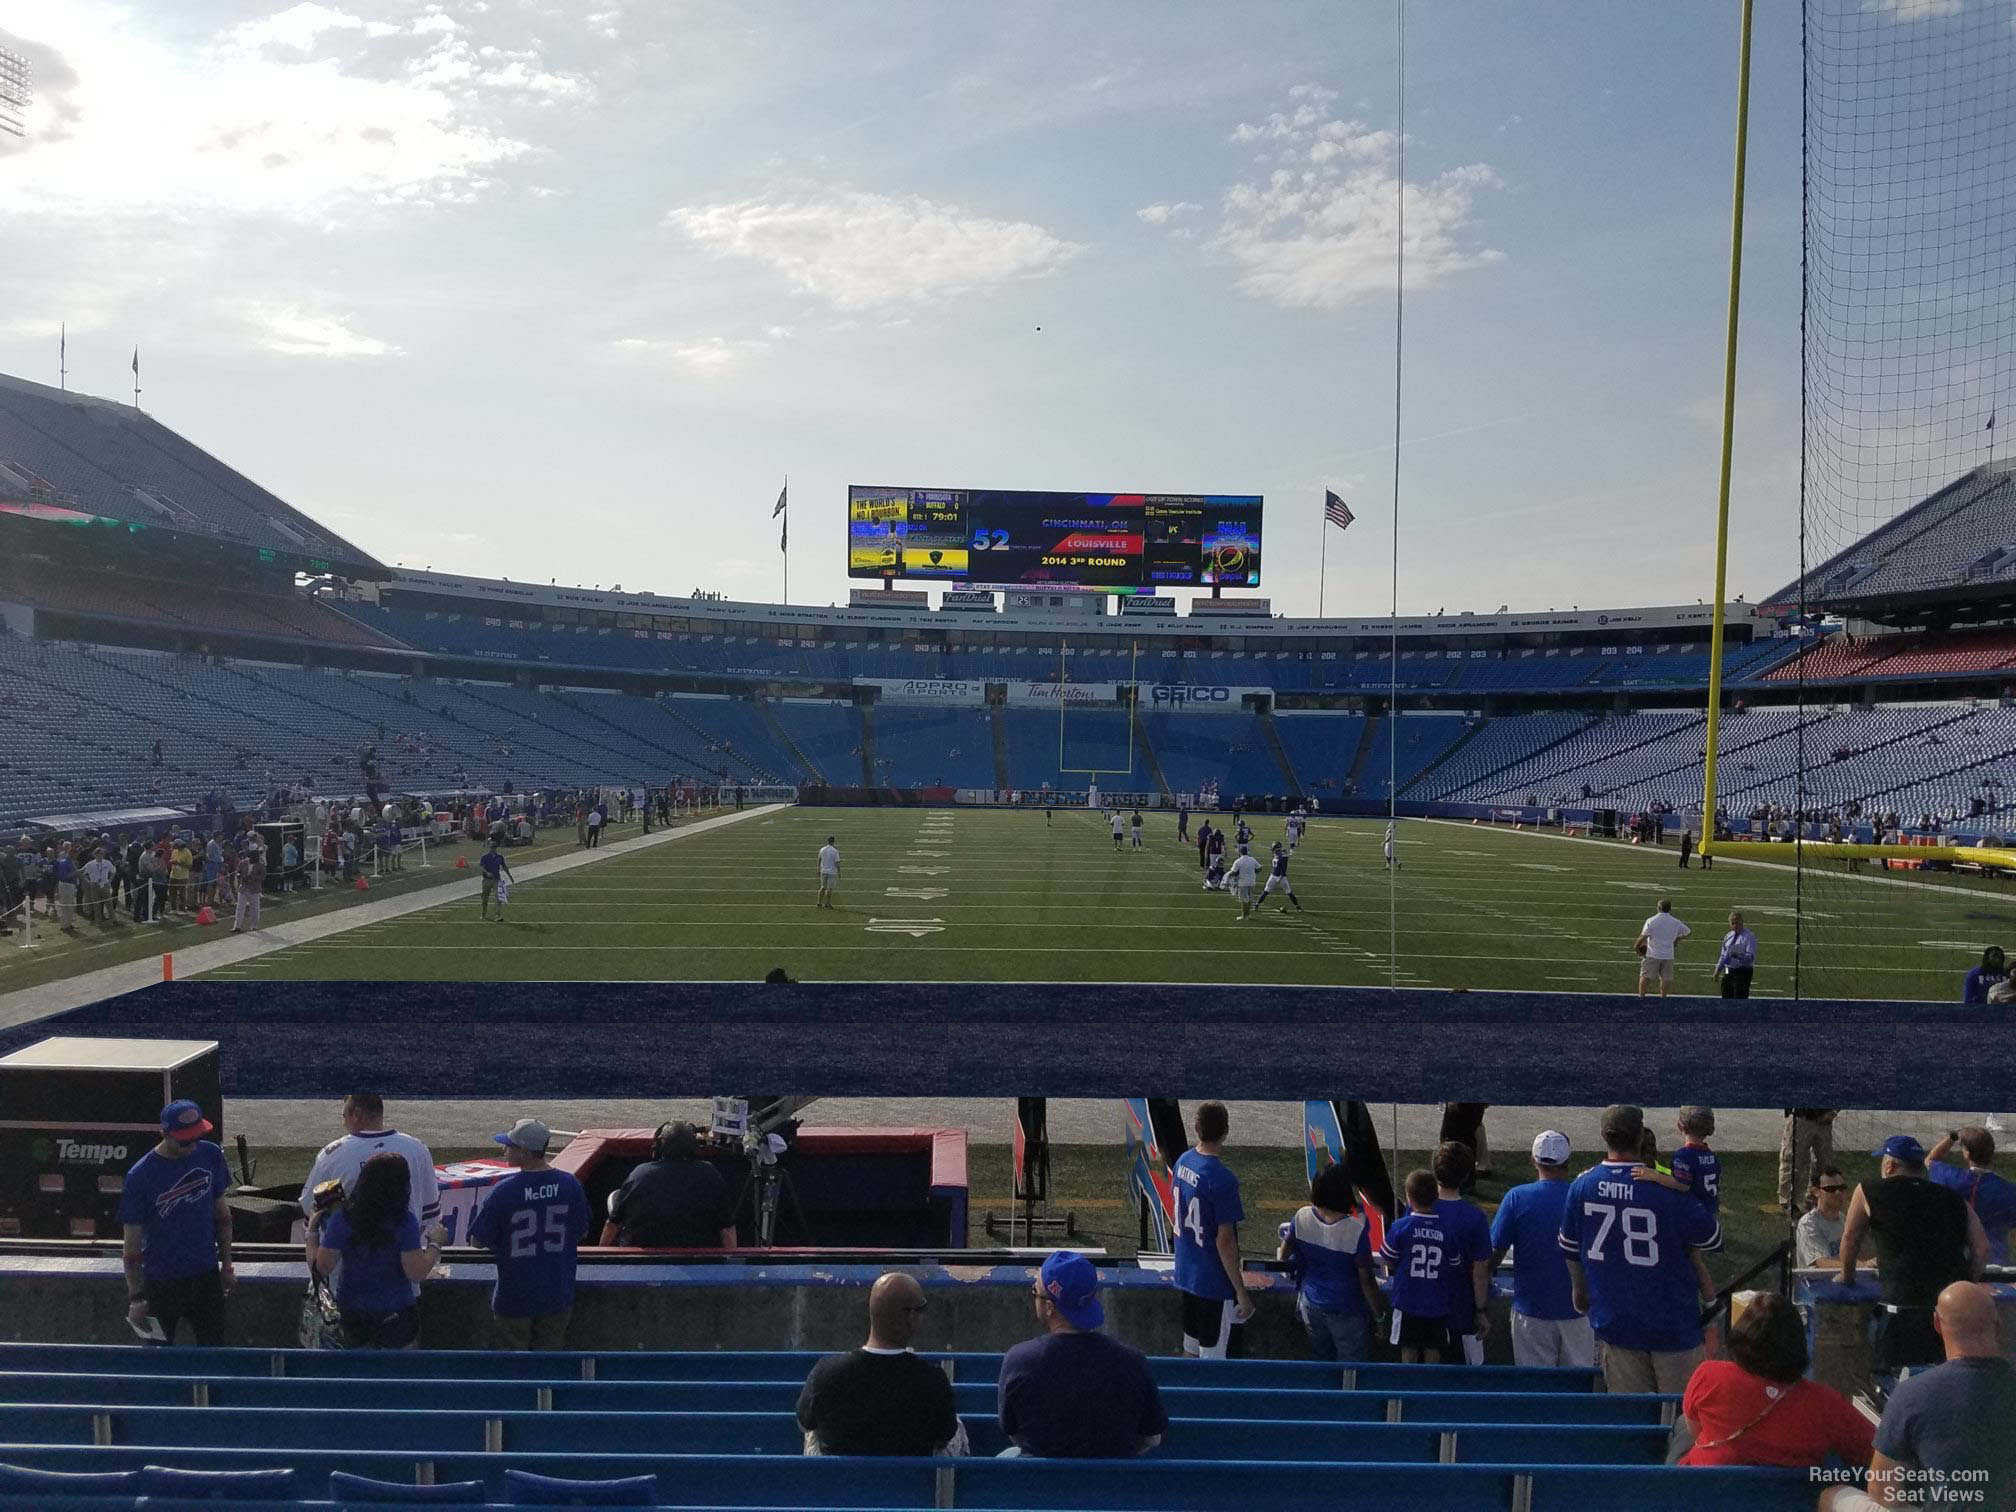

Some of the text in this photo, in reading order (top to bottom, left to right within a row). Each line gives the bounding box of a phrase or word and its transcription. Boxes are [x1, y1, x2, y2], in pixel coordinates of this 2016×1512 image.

[856, 500, 867, 509] THE
[932, 513, 958, 521] 79:01
[1042, 519, 1107, 530] CINCINNATI,
[973, 529, 1010, 550] 52
[1067, 540, 1127, 549] LOUISVILLE
[1042, 557, 1126, 566] 2014 3RD ROUND
[944, 592, 991, 602] FanDuel
[1124, 596, 1173, 607] FanDuel
[634, 630, 649, 639] 241
[657, 631, 672, 640] 242
[778, 639, 793, 648] 242
[800, 639, 815, 648] 243
[915, 644, 929, 652] 243
[1161, 650, 1176, 658] 200
[1446, 651, 1462, 659] 202
[1471, 650, 1487, 658] 203
[1601, 647, 1617, 655] 203
[1626, 646, 1642, 655] 204
[1298, 652, 1312, 660] 21
[1321, 652, 1337, 660] 202
[903, 681, 967, 692] ADPRO
[1028, 684, 1094, 698] Tim Hortons
[1152, 686, 1230, 701] GEICO
[56, 1139, 128, 1164] Tempo
[1177, 1163, 1201, 1188] WATKINS
[1704, 1173, 1717, 1197] 5
[525, 1184, 559, 1200] McCOY
[1598, 1182, 1633, 1200] SMITH
[1173, 1186, 1203, 1247] 14
[511, 1205, 569, 1256] 25
[1413, 1228, 1444, 1242] JACKSON
[1584, 1202, 1659, 1266] 78
[1410, 1244, 1442, 1279] 22
